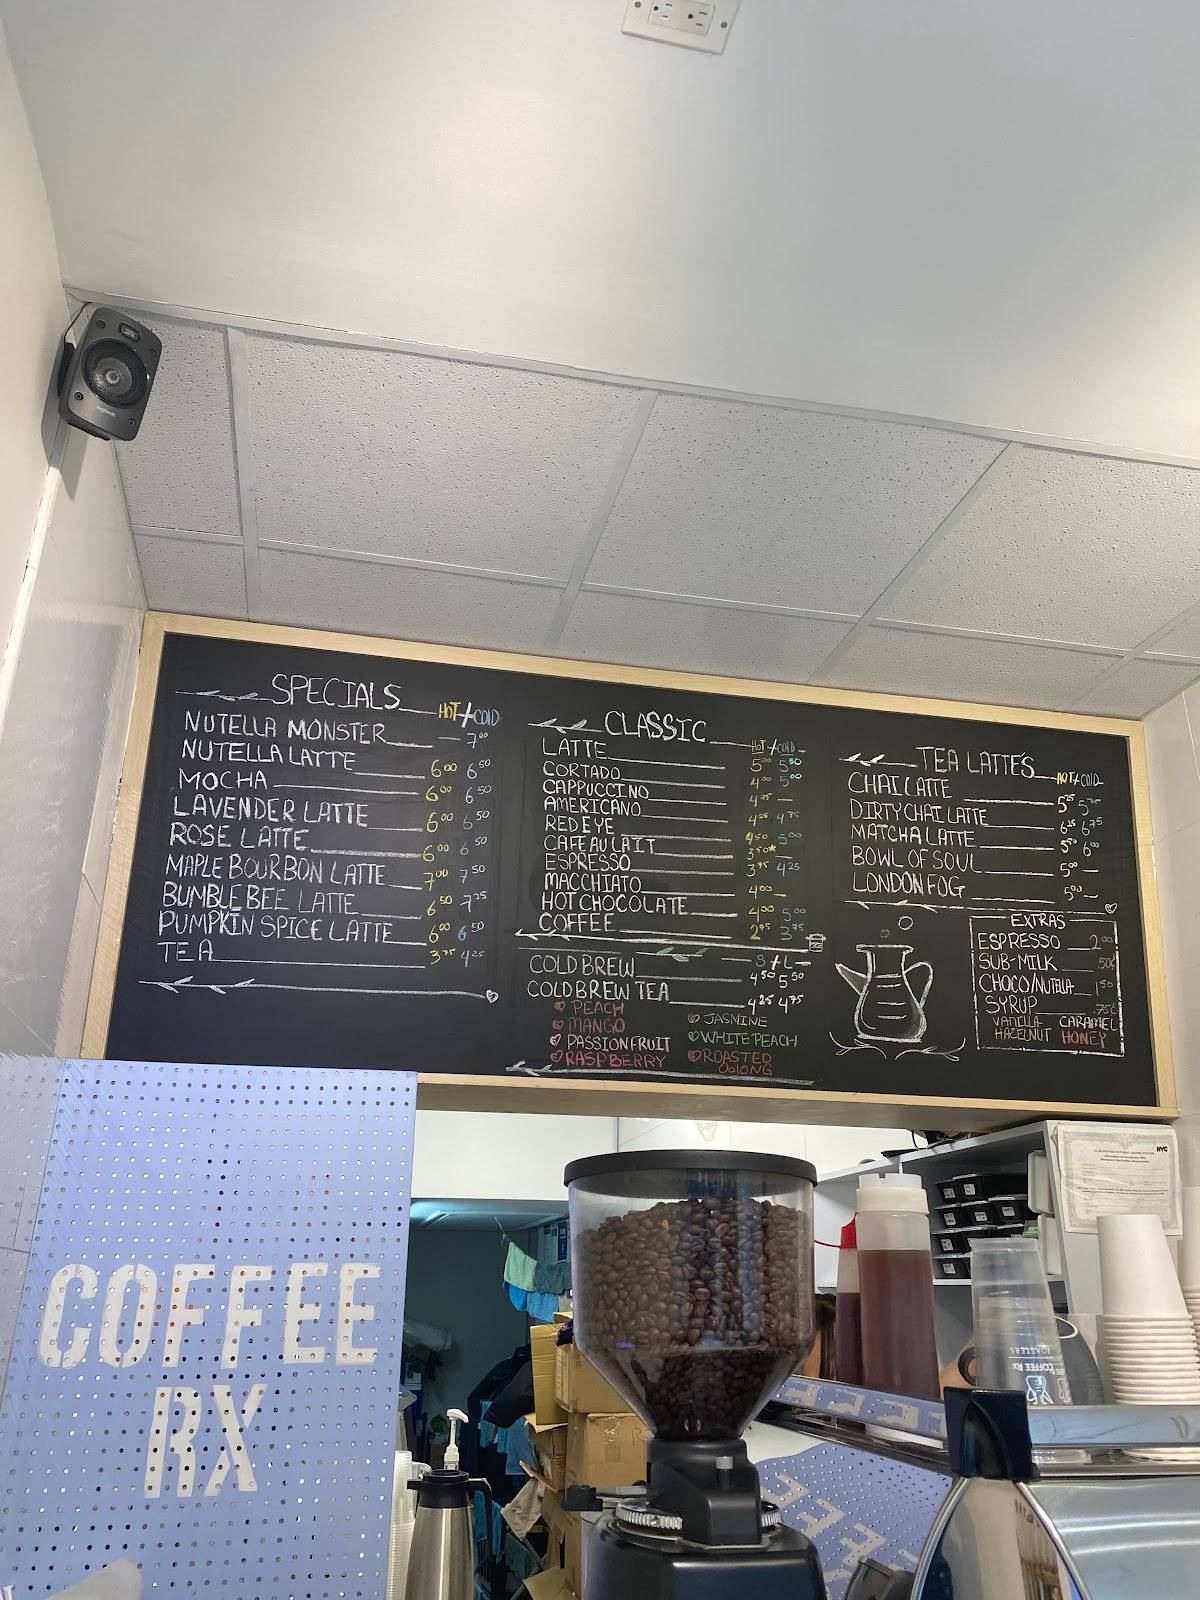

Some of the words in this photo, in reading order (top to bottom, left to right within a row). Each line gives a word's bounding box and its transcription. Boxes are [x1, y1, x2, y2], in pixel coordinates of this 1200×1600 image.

[272, 673, 402, 710] SPECIALS
[185, 710, 277, 738] NUTELLA
[288, 719, 386, 744] MONSTER
[604, 710, 707, 742] CLASSIC
[181, 738, 283, 764] NUTELLA
[289, 746, 356, 771] LATTE
[542, 737, 607, 760] LATTE
[916, 746, 959, 773] TEA
[179, 768, 267, 790] MOCHA
[543, 760, 621, 780] CORTADO
[542, 779, 649, 799] CAPPUCCINO
[848, 771, 902, 796] CHAI
[904, 776, 952, 799] LATTE
[173, 794, 296, 823] LAVENDER
[304, 801, 369, 827] LATTE
[544, 795, 641, 817] AMERICANO
[850, 798, 901, 821] DIRTY
[904, 803, 945, 823] CHAI
[947, 806, 989, 826] LATTE
[169, 822, 231, 848] ROSE
[240, 825, 309, 851] LATTE
[851, 823, 921, 845] MATCHA
[926, 826, 978, 848] LATTE
[165, 853, 223, 879] MAPLE
[228, 853, 323, 884] BOURBON
[330, 861, 386, 886] LATTE
[545, 852, 631, 872] ESPRESSO
[852, 845, 905, 868] BOWL
[908, 848, 928, 869] OF
[932, 850, 982, 873] SOUL
[544, 872, 642, 894] MACCHIATO
[853, 871, 924, 896] LONDON
[927, 873, 966, 898] FOG
[298, 889, 358, 915] LATTE
[541, 891, 577, 911] HOT
[579, 894, 688, 916] CHOCOLATE
[158, 910, 254, 937] PUMPKIN
[260, 915, 323, 940] SPICE
[329, 920, 393, 943] LATTE
[539, 912, 617, 932] COFFEE
[1010, 913, 1066, 929] EXTRAS
[156, 939, 214, 963] TEA
[977, 932, 1061, 950] ESPRESSO
[978, 952, 1058, 972] SUB-MILK
[635, 980, 670, 1001] TEA
[571, 1000, 625, 1016] PEACH
[985, 994, 1038, 1015] SYRUP
[569, 1017, 625, 1034] MANGO
[703, 1013, 768, 1027] JASMINE
[1060, 1015, 1118, 1031] CARAMEL
[1061, 1030, 1107, 1049] HONEY
[565, 1050, 666, 1068] RASPBERRY
[702, 1048, 772, 1064] ROASTED
[37, 1263, 381, 1368] COFFEE
[143, 1383, 268, 1498] RX
